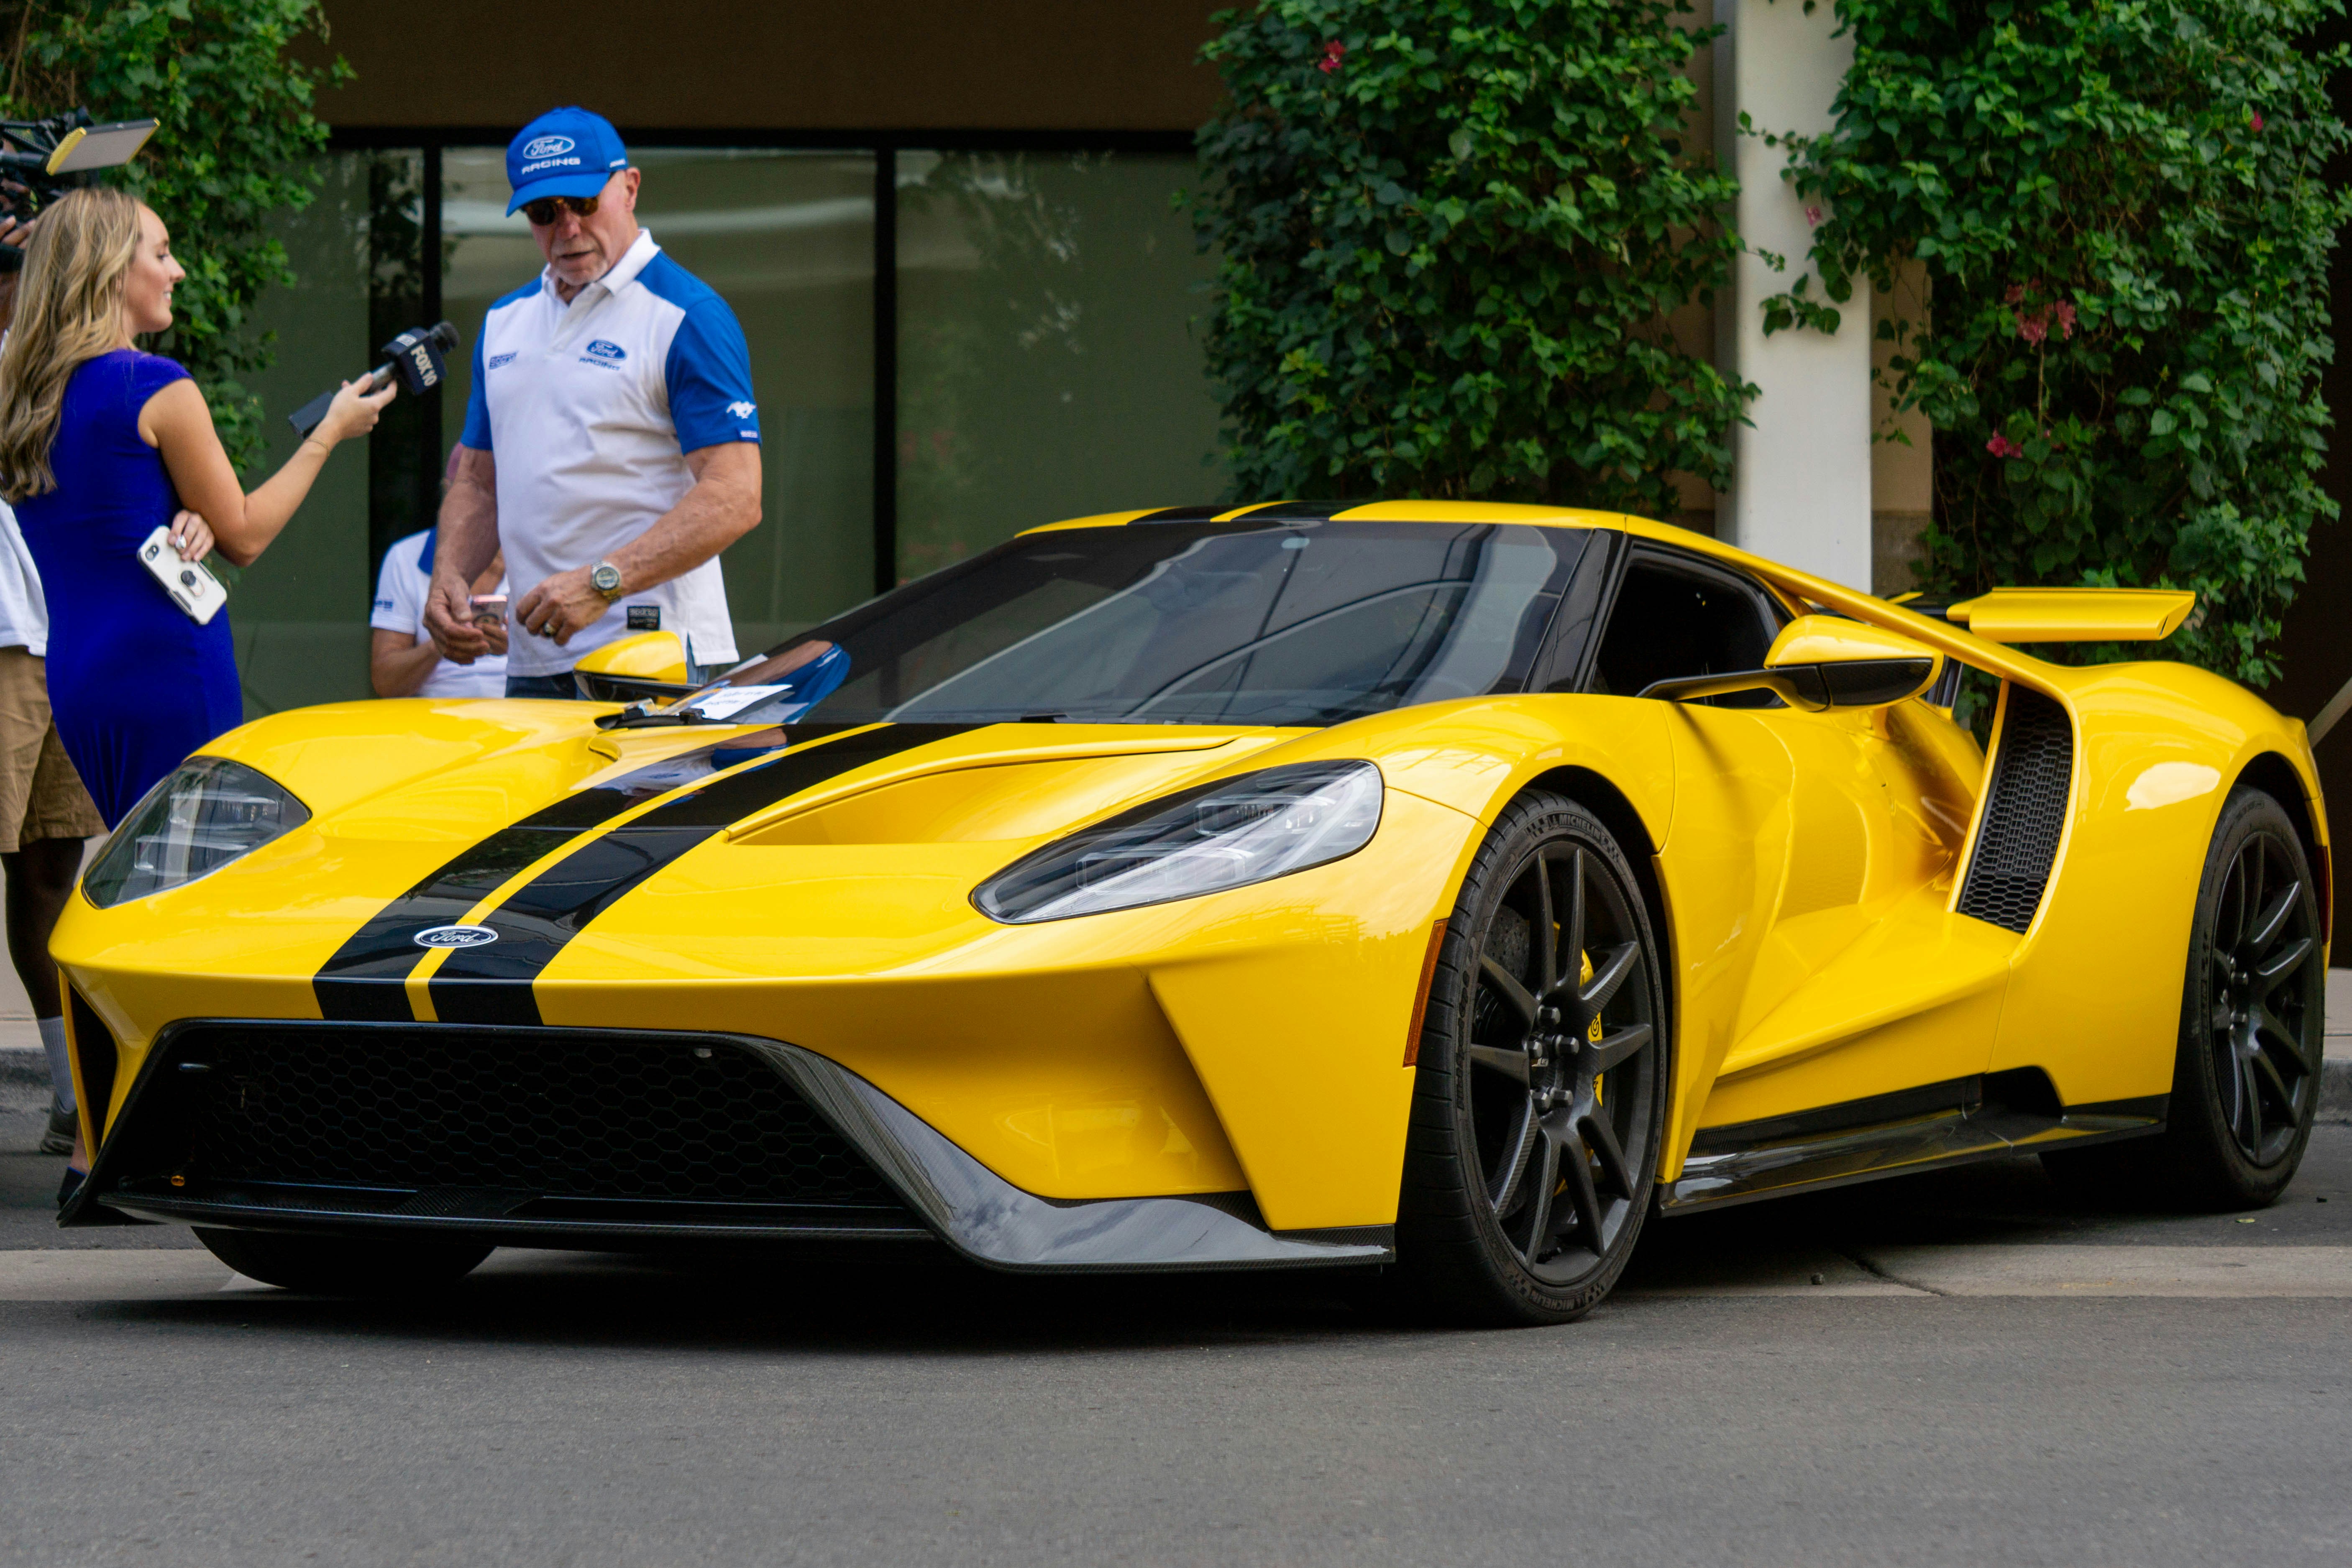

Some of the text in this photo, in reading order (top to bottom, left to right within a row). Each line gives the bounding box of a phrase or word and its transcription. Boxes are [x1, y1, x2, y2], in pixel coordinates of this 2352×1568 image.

[531, 138, 563, 156] Ford
[522, 157, 581, 175] RACING
[591, 342, 619, 358] Ford
[410, 343, 438, 386] FOX 10
[1559, 814, 1602, 841] MICHELIN
[430, 930, 480, 943] Ford
[1529, 1288, 1575, 1310] MICHELIN
